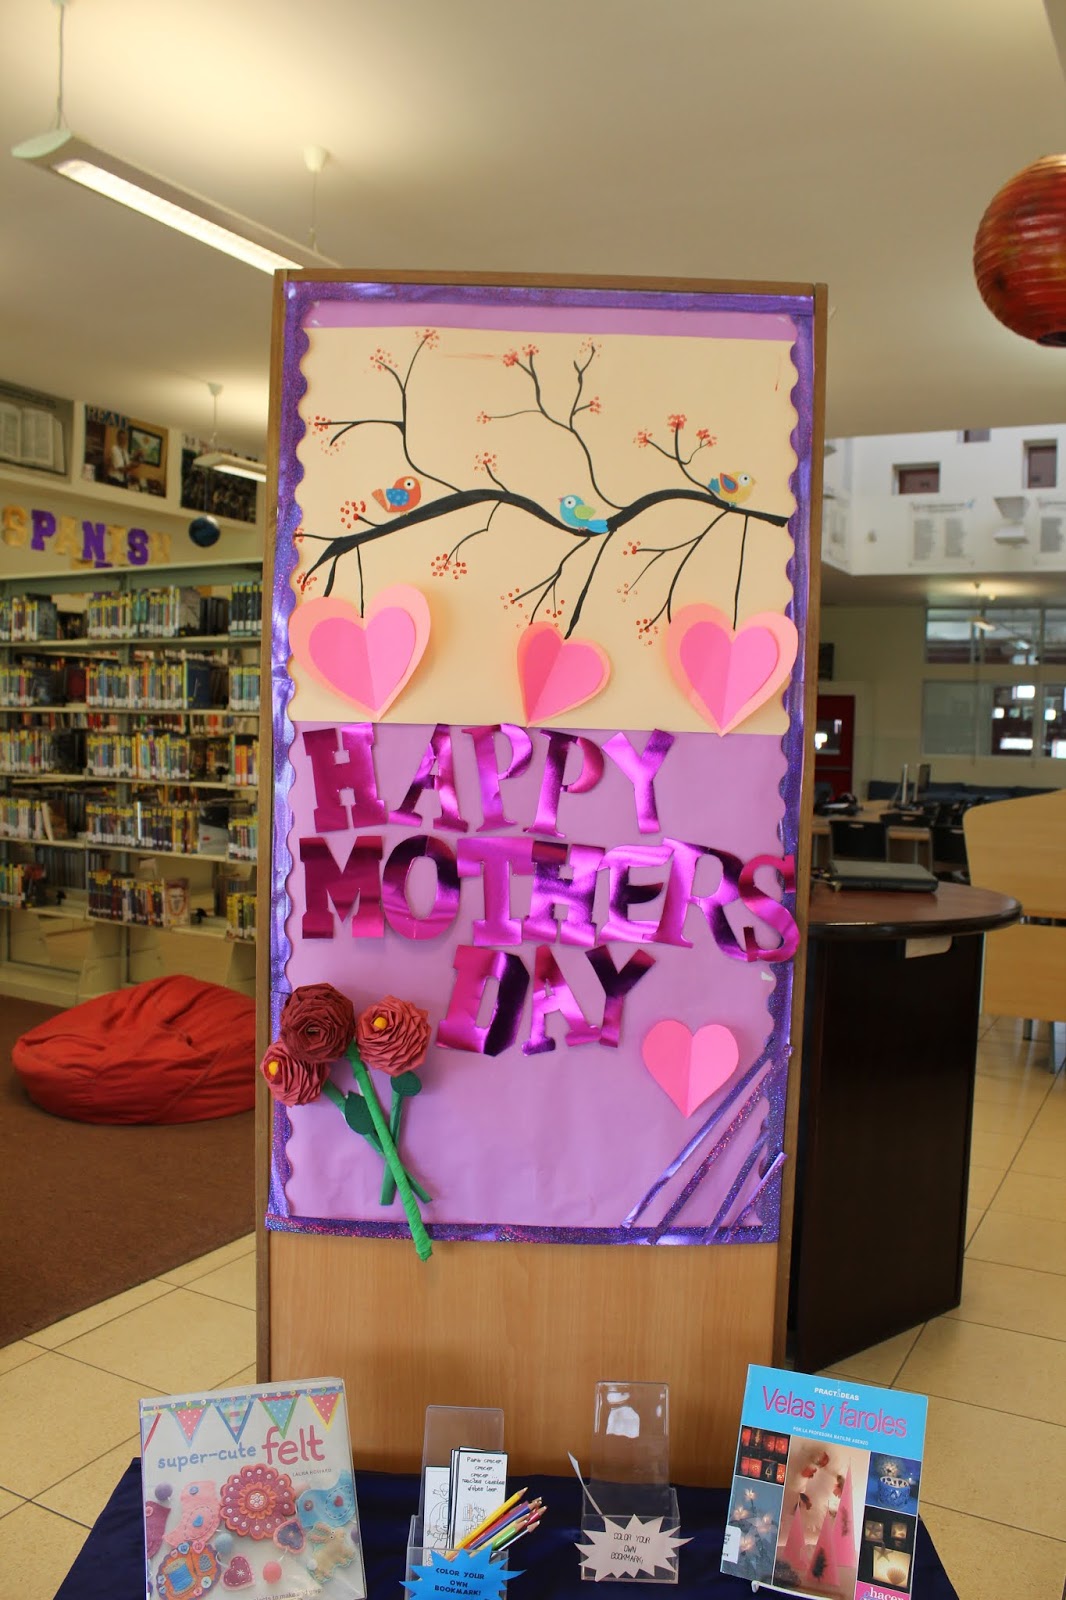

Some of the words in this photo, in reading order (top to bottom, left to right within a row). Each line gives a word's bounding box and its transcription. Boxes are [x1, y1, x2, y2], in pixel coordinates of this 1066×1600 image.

[2, 504, 172, 568] SPANISH
[302, 722, 675, 838] HAPPY
[298, 834, 801, 963] MOTHERS
[436, 944, 656, 1057] DAY
[762, 1385, 816, 1420] Velas
[820, 1403, 835, 1428] y
[838, 1401, 908, 1439] faroles
[157, 1441, 257, 1472] super-cute
[261, 1425, 326, 1466] felt
[613, 1532, 632, 1541] COLOR
[635, 1535, 651, 1544] YOUR
[623, 1544, 637, 1554] OWN
[434, 1585, 482, 1596] BOOKMARK!
[435, 1567, 460, 1577] COLOR
[463, 1571, 485, 1580] YOUR
[449, 1580, 469, 1588] OWN
